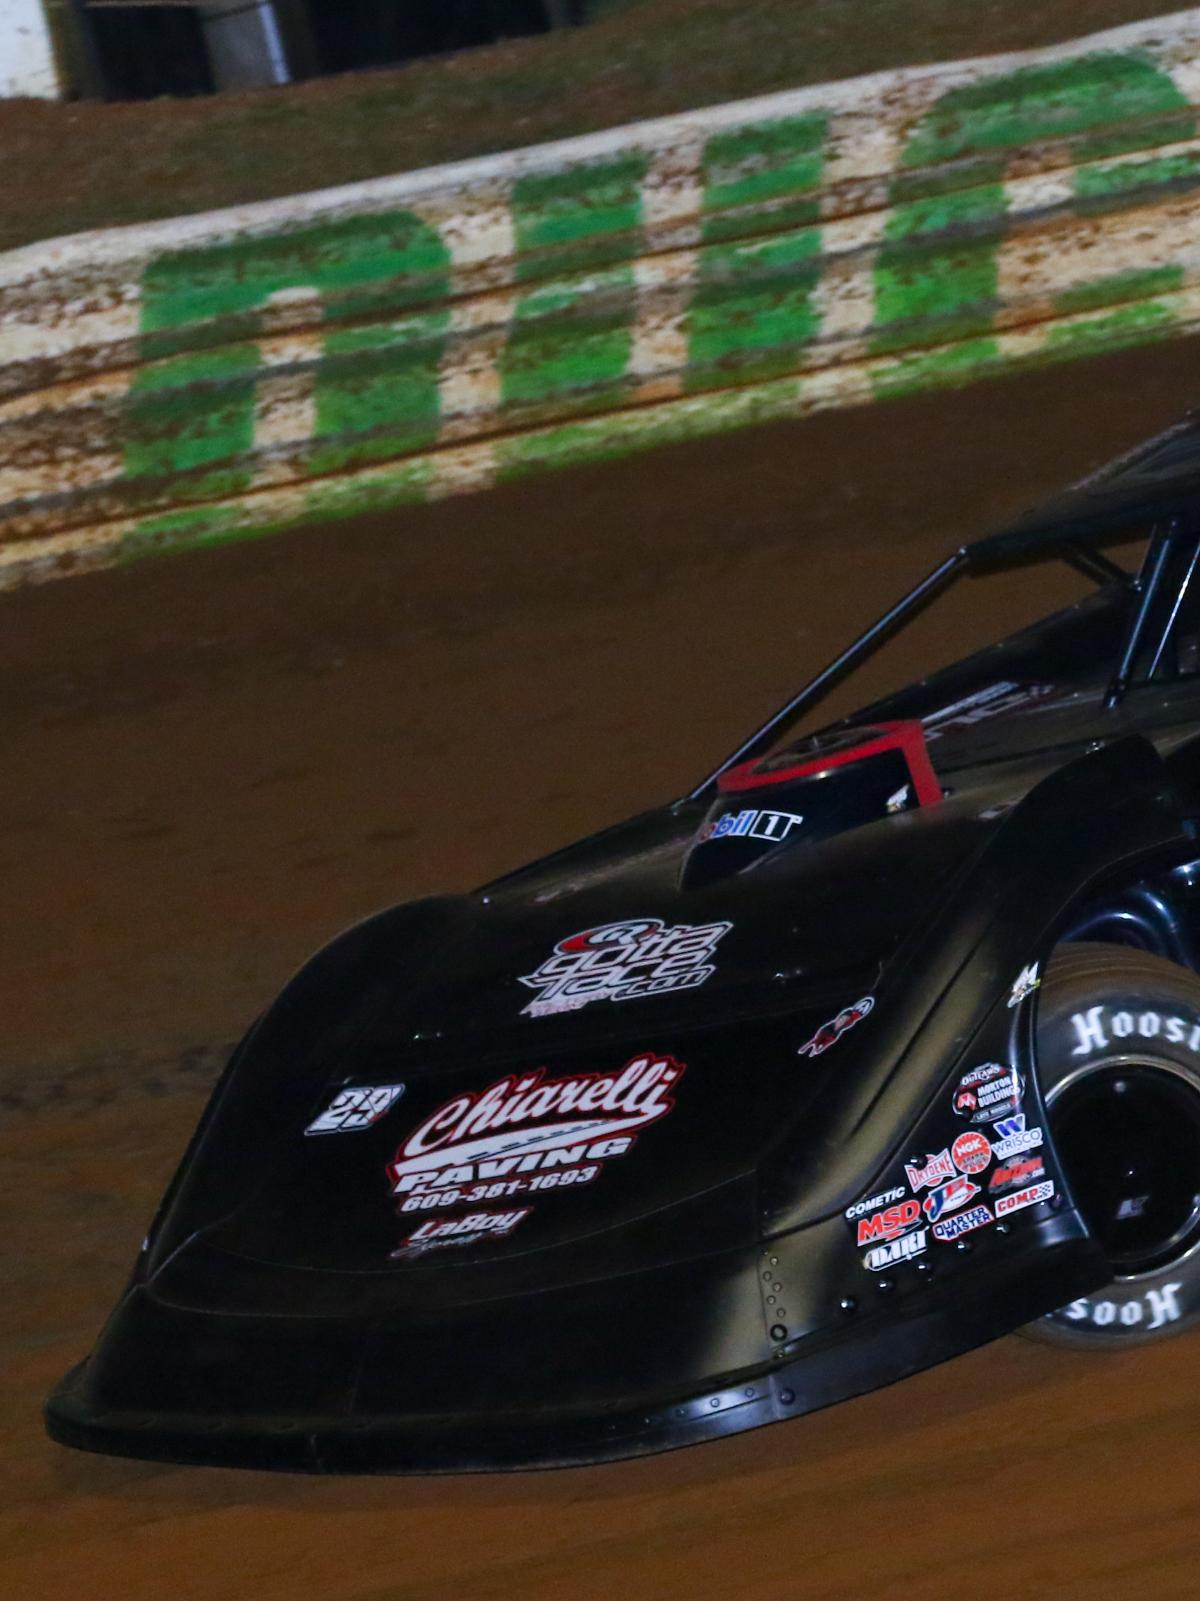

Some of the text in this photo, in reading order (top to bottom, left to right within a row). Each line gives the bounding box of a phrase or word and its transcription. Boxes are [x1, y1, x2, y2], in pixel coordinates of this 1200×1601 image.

[977, 1076, 1011, 1095] MORTON
[404, 1060, 680, 1157] Chiarelli
[955, 1139, 982, 1157] NGK
[992, 1130, 1041, 1154] WRISCO
[394, 1137, 635, 1194] PAVING
[908, 1155, 955, 1188] DRYDENE
[401, 1166, 598, 1212] 609-381-1693
[845, 1186, 906, 1220] COMETIC
[997, 1187, 1039, 1213] COMP
[857, 1199, 921, 1243] MSD
[935, 1207, 987, 1238] QUARTER
[946, 1213, 990, 1239] MASTER
